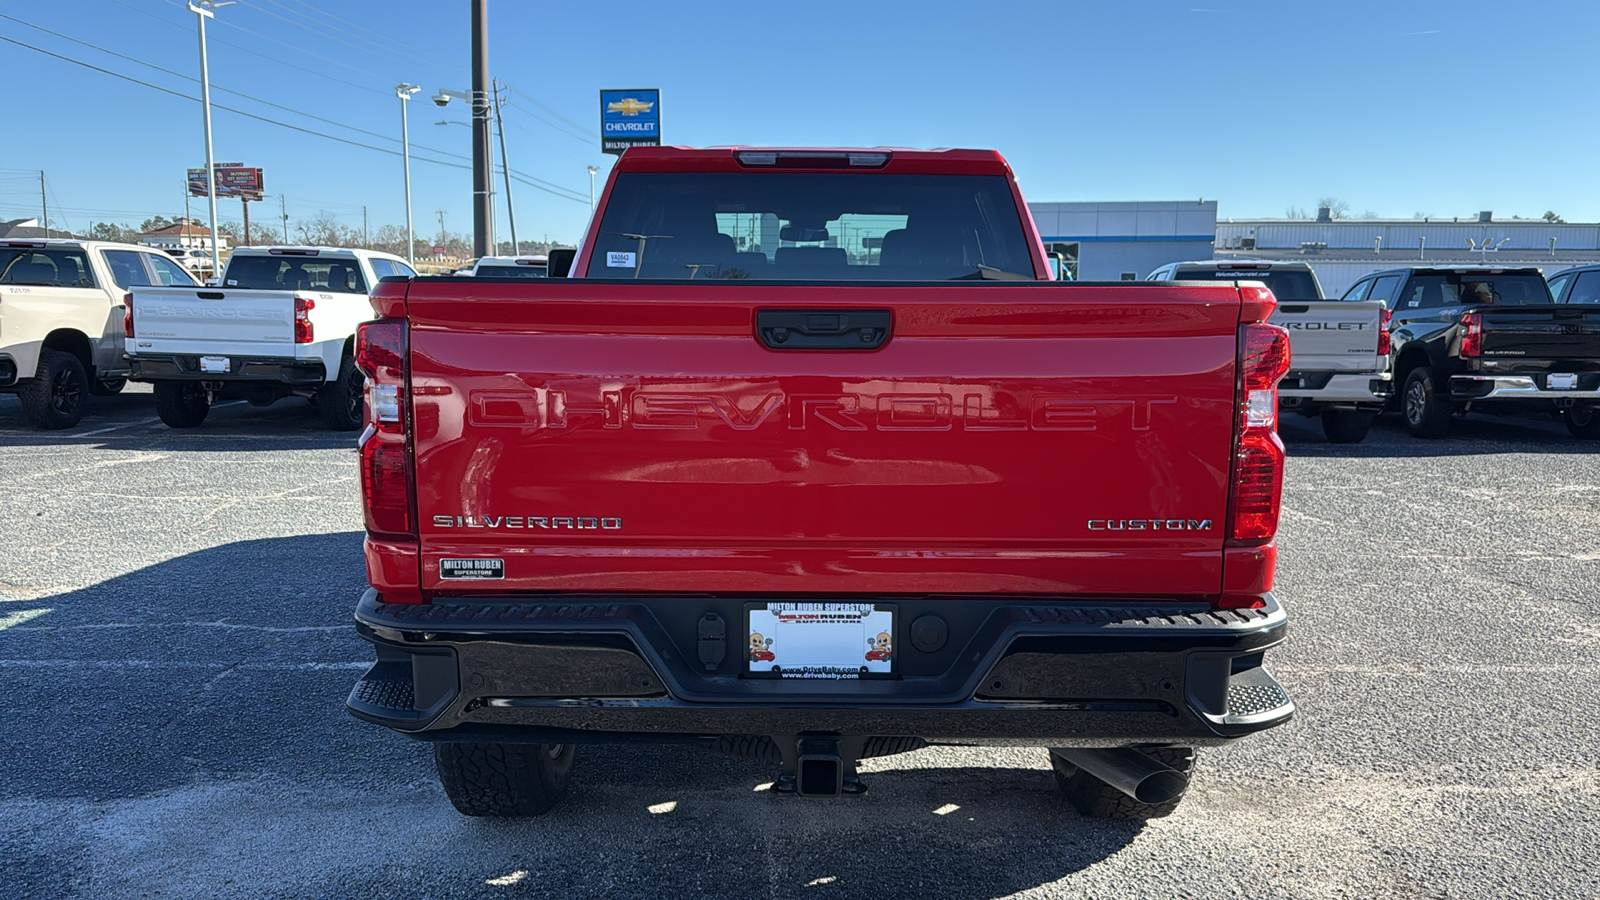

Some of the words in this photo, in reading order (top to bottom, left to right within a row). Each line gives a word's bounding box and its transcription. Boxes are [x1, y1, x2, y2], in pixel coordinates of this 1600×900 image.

[606, 123, 655, 131] CHEVROLET
[605, 141, 630, 149] MILTON
[468, 388, 1178, 432] CHEVROLET
[432, 515, 622, 530] SILVERADO
[1087, 519, 1212, 531] CUSTOM
[443, 560, 473, 570] MILTON
[474, 560, 501, 570] RUBEN
[767, 602, 796, 611] MILTON
[797, 602, 824, 611] RUBEN
[825, 602, 875, 612] SUPERSTORE
[781, 672, 859, 680] www.drivebaby.com
